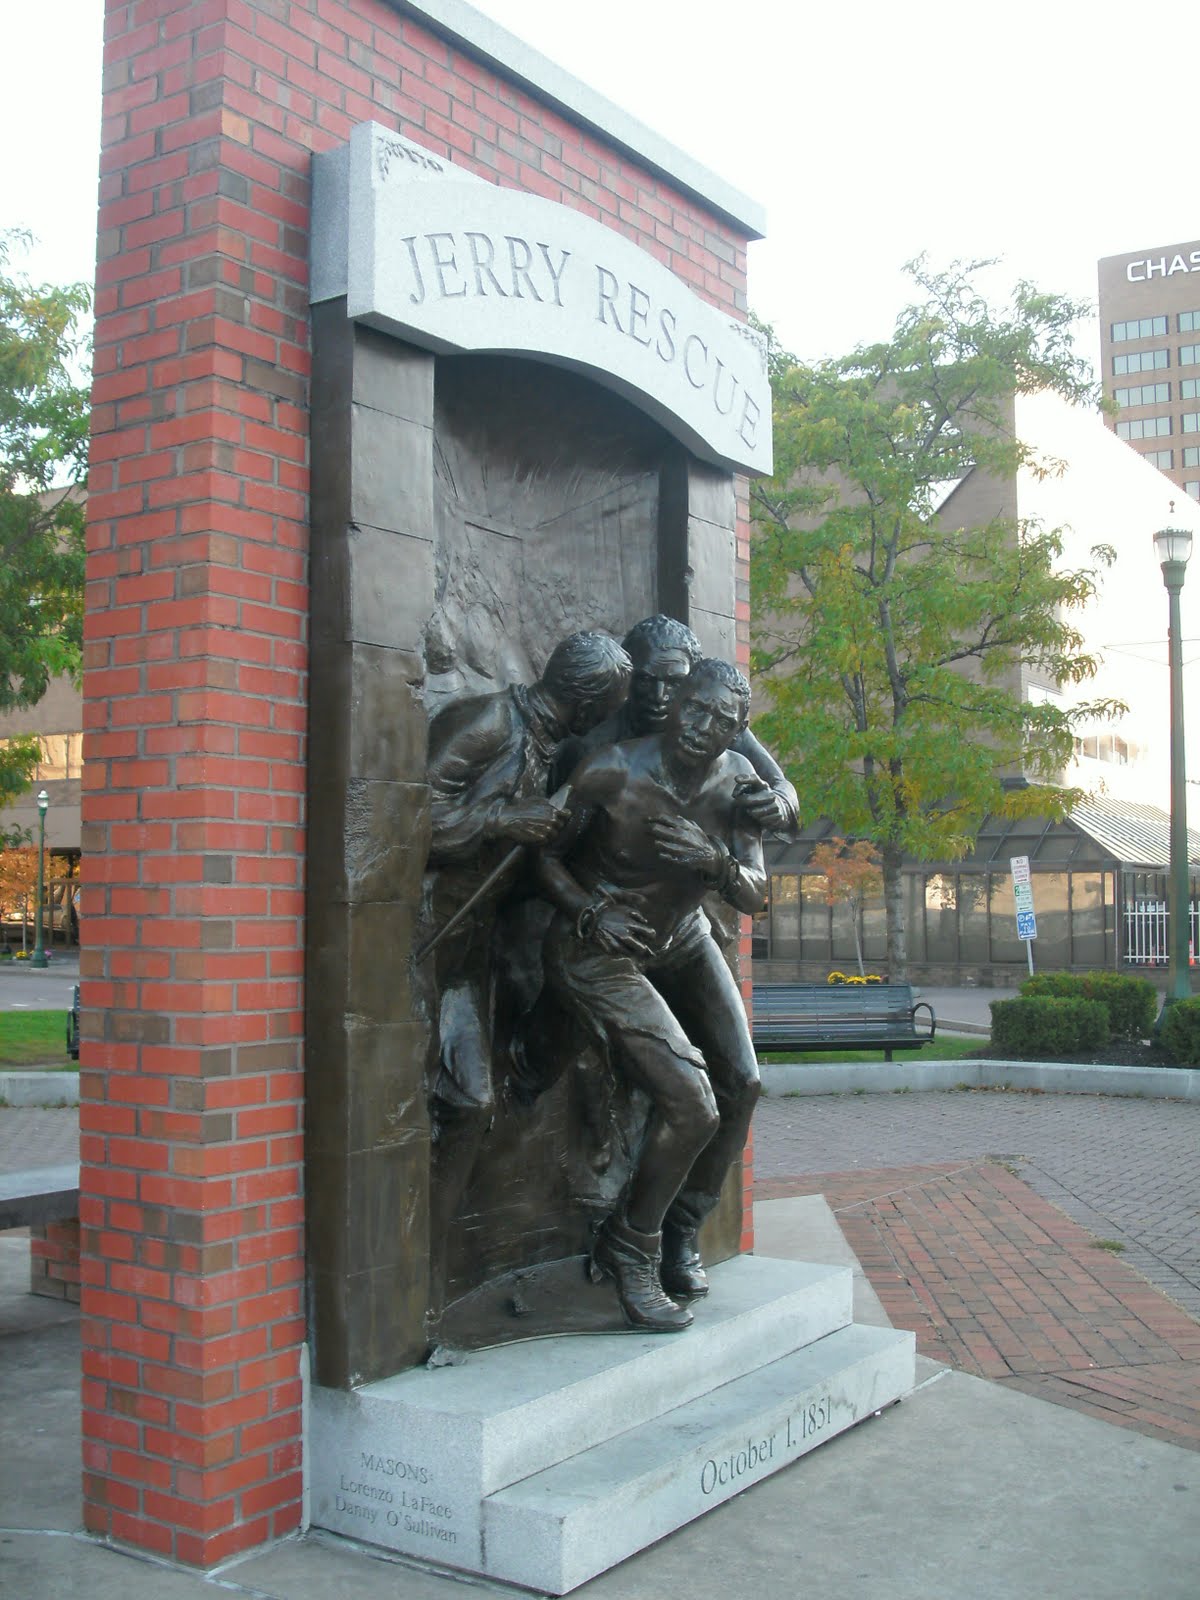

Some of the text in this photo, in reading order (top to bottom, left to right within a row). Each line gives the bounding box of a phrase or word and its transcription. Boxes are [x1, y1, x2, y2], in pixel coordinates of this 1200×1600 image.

[400, 231, 761, 451] JERRY RESCUE
[701, 1394, 831, 1495] October 1, 1851
[335, 1494, 457, 1544] Danny O'Sullivan
[340, 1474, 452, 1519] Lorenzo LaFace
